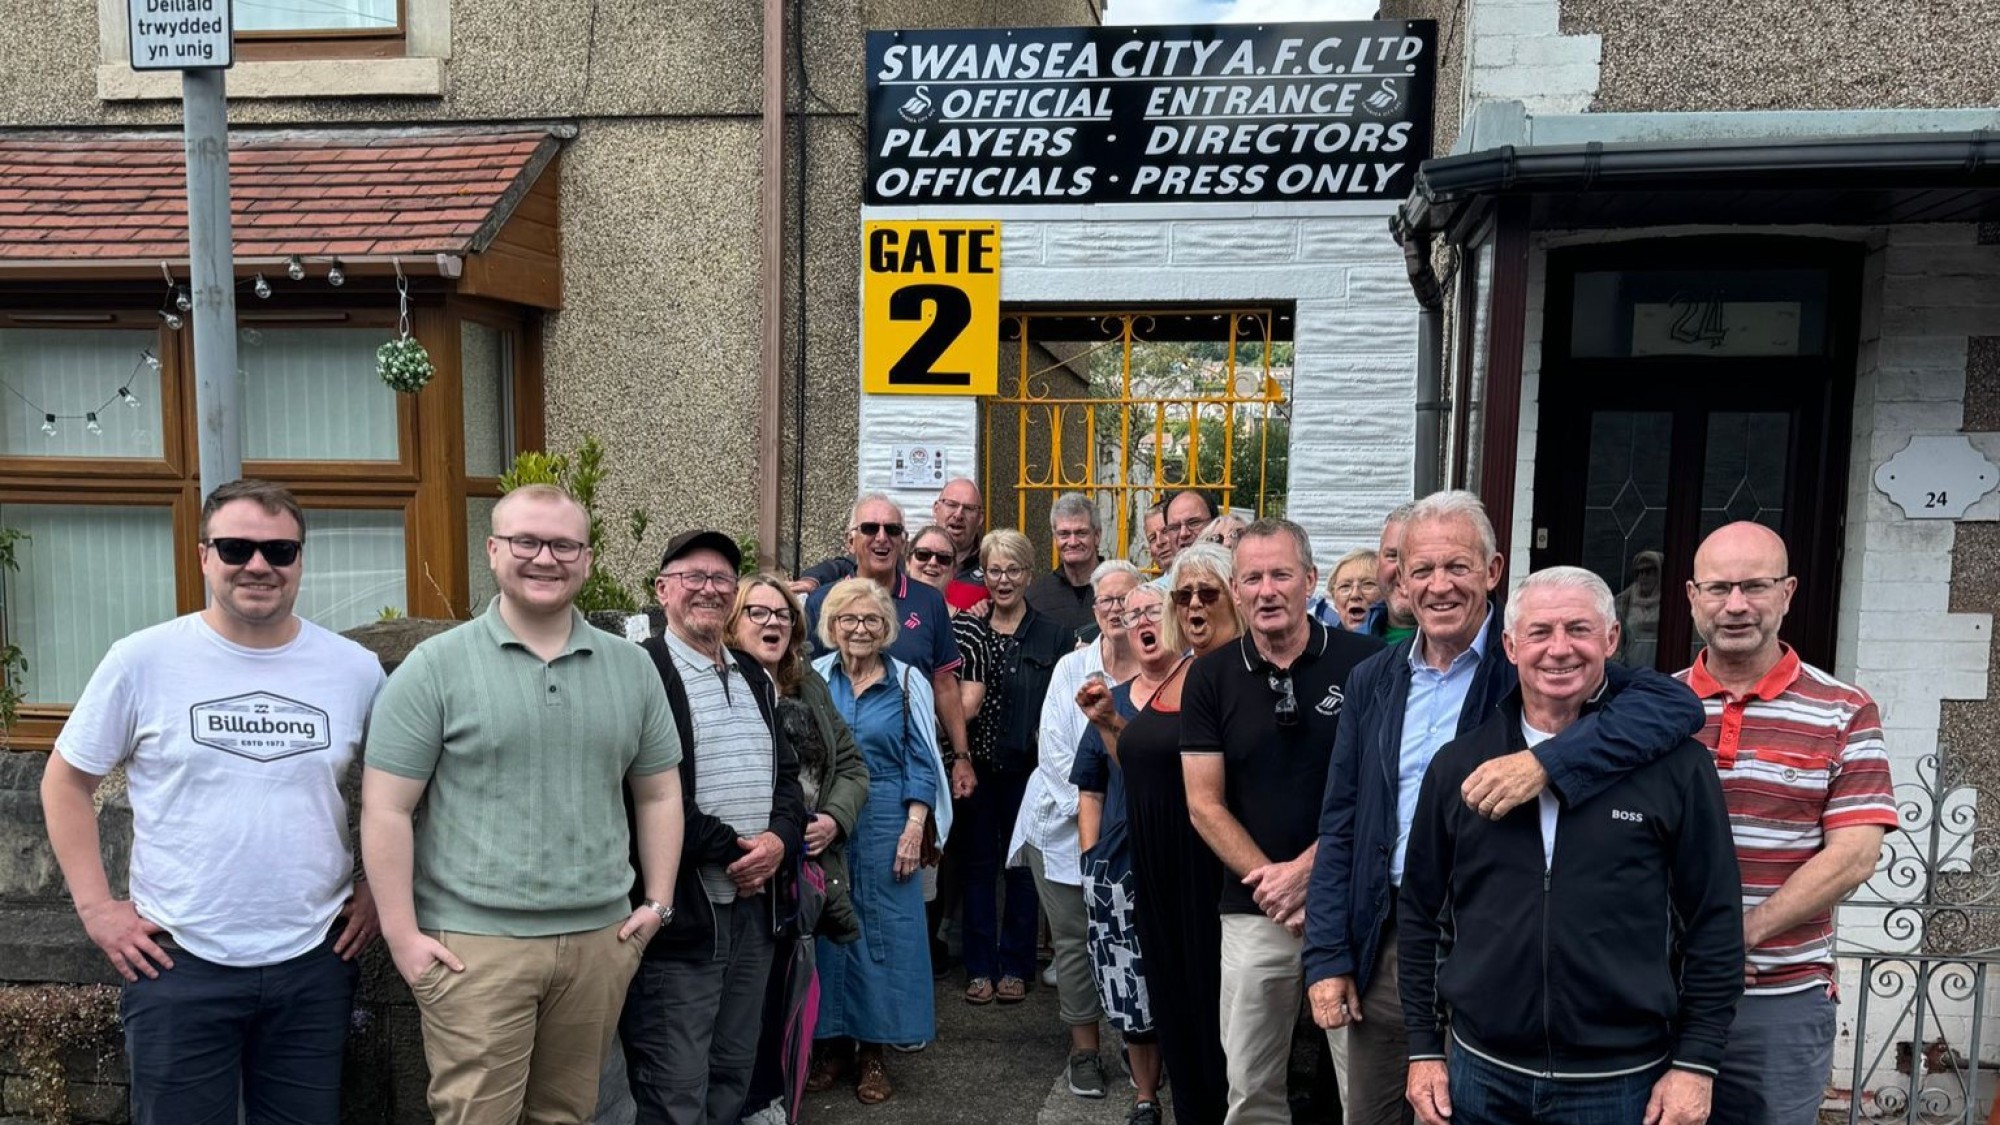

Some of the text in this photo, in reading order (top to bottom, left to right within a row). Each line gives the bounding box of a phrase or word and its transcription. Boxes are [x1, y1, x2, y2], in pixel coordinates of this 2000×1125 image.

[138, 16, 222, 38] trwydded
[148, 39, 213, 60] yn unig
[878, 42, 1098, 80] SWANSEA
[1111, 39, 1222, 77] CITY
[1221, 37, 1345, 76] A.F.C.
[942, 88, 1112, 118] OFFICIAL
[1145, 83, 1362, 115] ENTRANCE
[879, 122, 1413, 157] PLAYERS DIRECTORS
[876, 162, 1405, 196] OFFICIALS PRESS ONLY
[869, 228, 994, 274] GATE
[888, 283, 972, 385] 2
[1668, 290, 1729, 350] 24
[1925, 491, 1948, 508] 24
[208, 715, 315, 739] Billabong
[1612, 809, 1643, 823] BOSS
